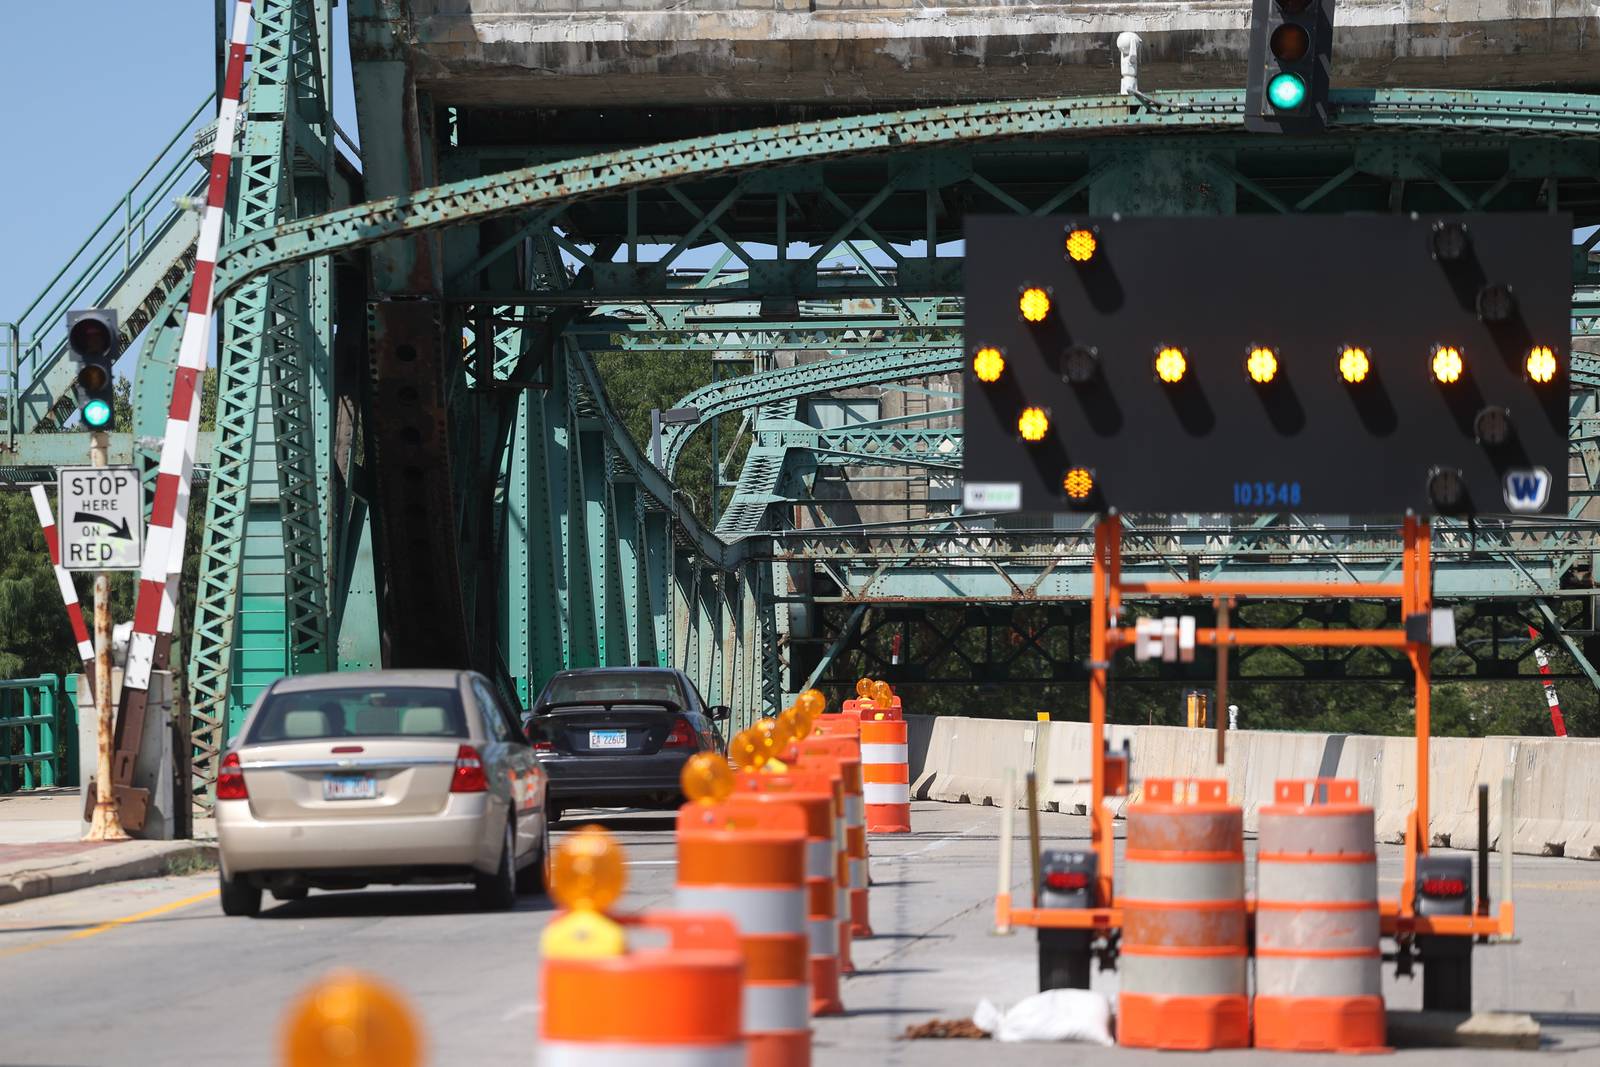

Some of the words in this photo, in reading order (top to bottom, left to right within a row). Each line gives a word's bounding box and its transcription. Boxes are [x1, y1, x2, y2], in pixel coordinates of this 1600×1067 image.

[72, 476, 127, 496] STOP
[1233, 480, 1302, 506] 103548
[1511, 476, 1541, 501] W
[82, 499, 118, 511] HERE
[82, 525, 99, 537] ON
[70, 543, 113, 561] RED
